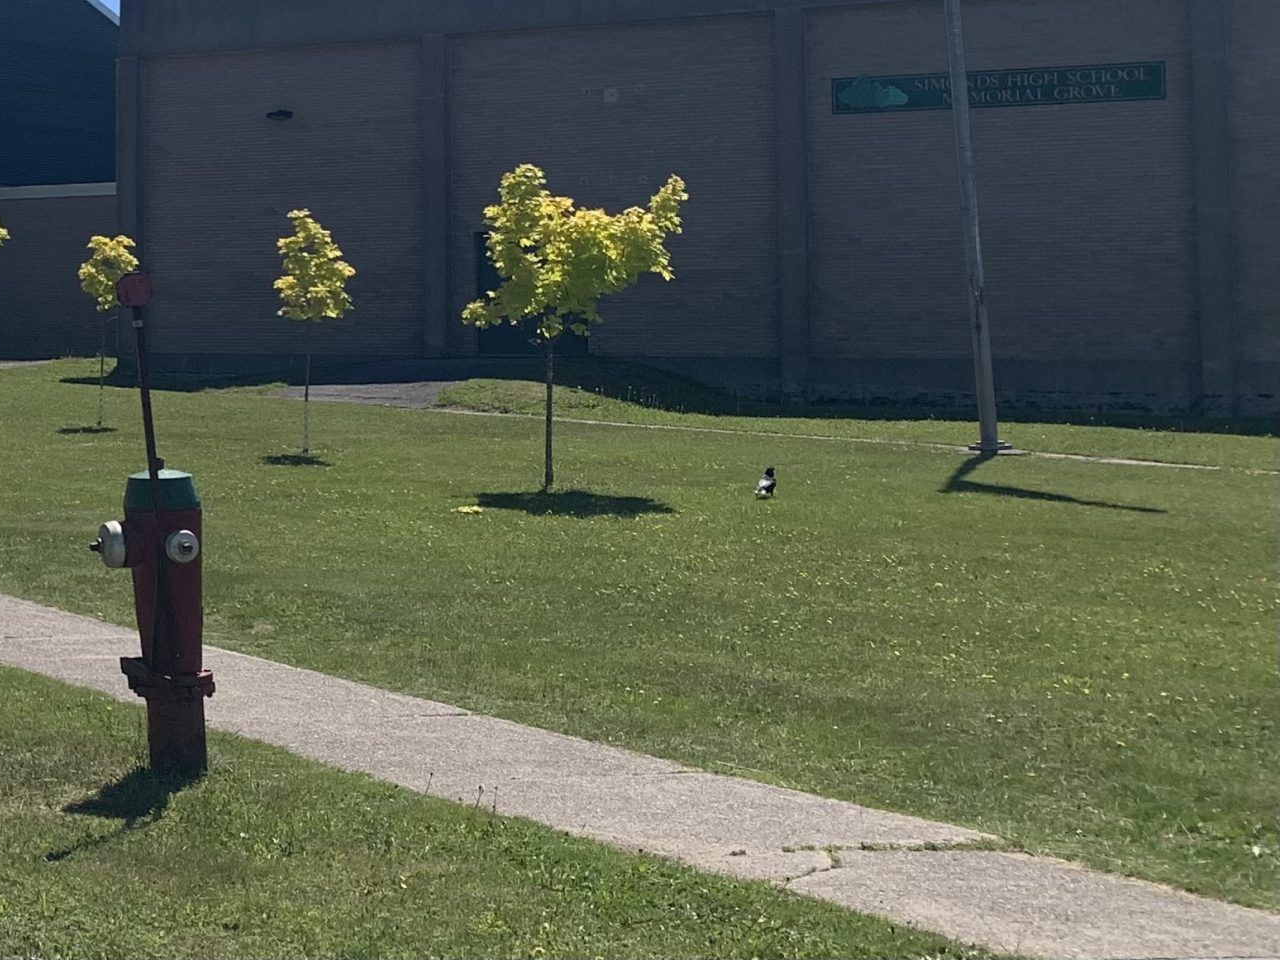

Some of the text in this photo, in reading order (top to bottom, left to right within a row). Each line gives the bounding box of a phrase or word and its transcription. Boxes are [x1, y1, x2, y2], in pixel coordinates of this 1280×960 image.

[1007, 72, 1058, 87] HIGH
[1066, 68, 1150, 83] SCHOOL
[942, 85, 1122, 104] MMORIAL GROVE
